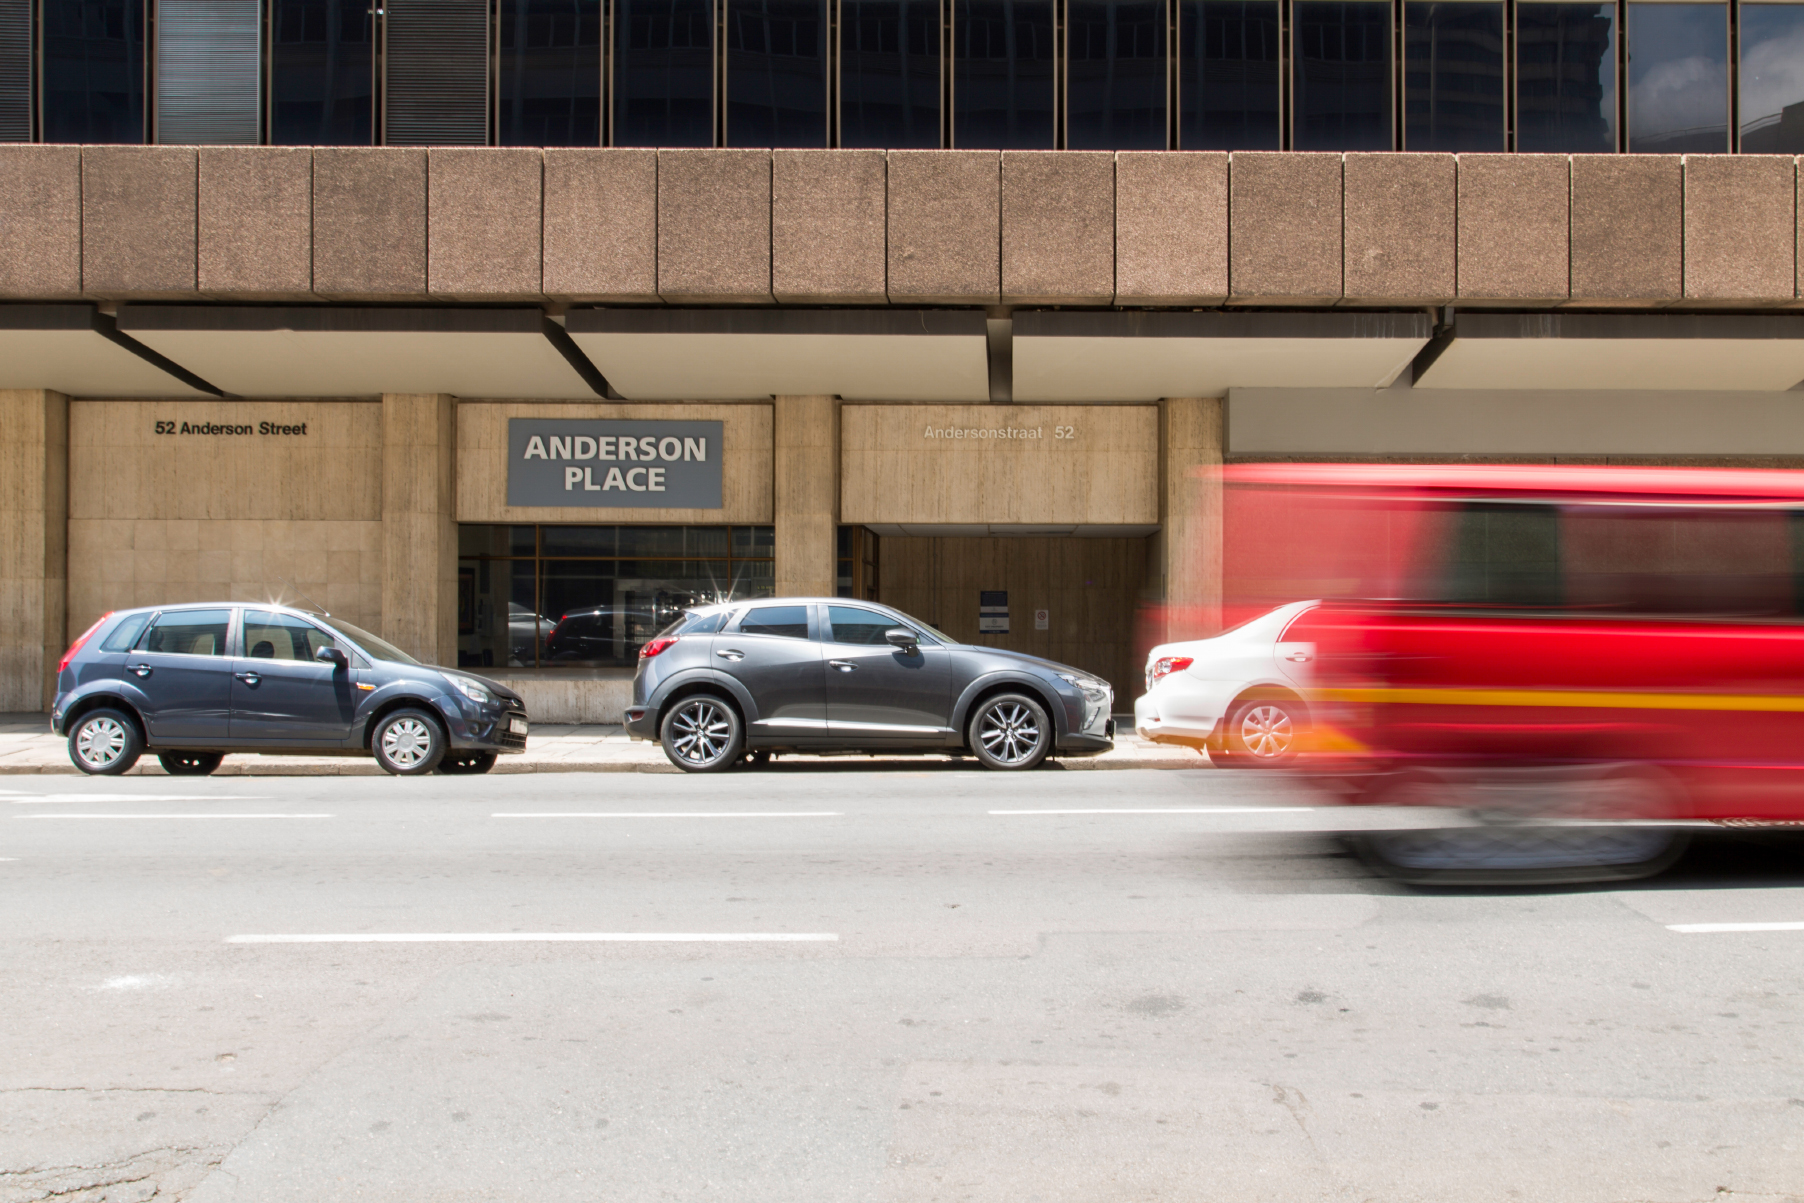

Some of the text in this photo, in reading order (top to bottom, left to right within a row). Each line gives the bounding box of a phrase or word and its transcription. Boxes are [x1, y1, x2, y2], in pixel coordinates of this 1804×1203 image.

[155, 421, 307, 435] 52 Anderson Street
[924, 425, 1075, 439] Andersonstraat 52
[524, 435, 706, 462] ANDERSON
[564, 466, 666, 492] PLACE
